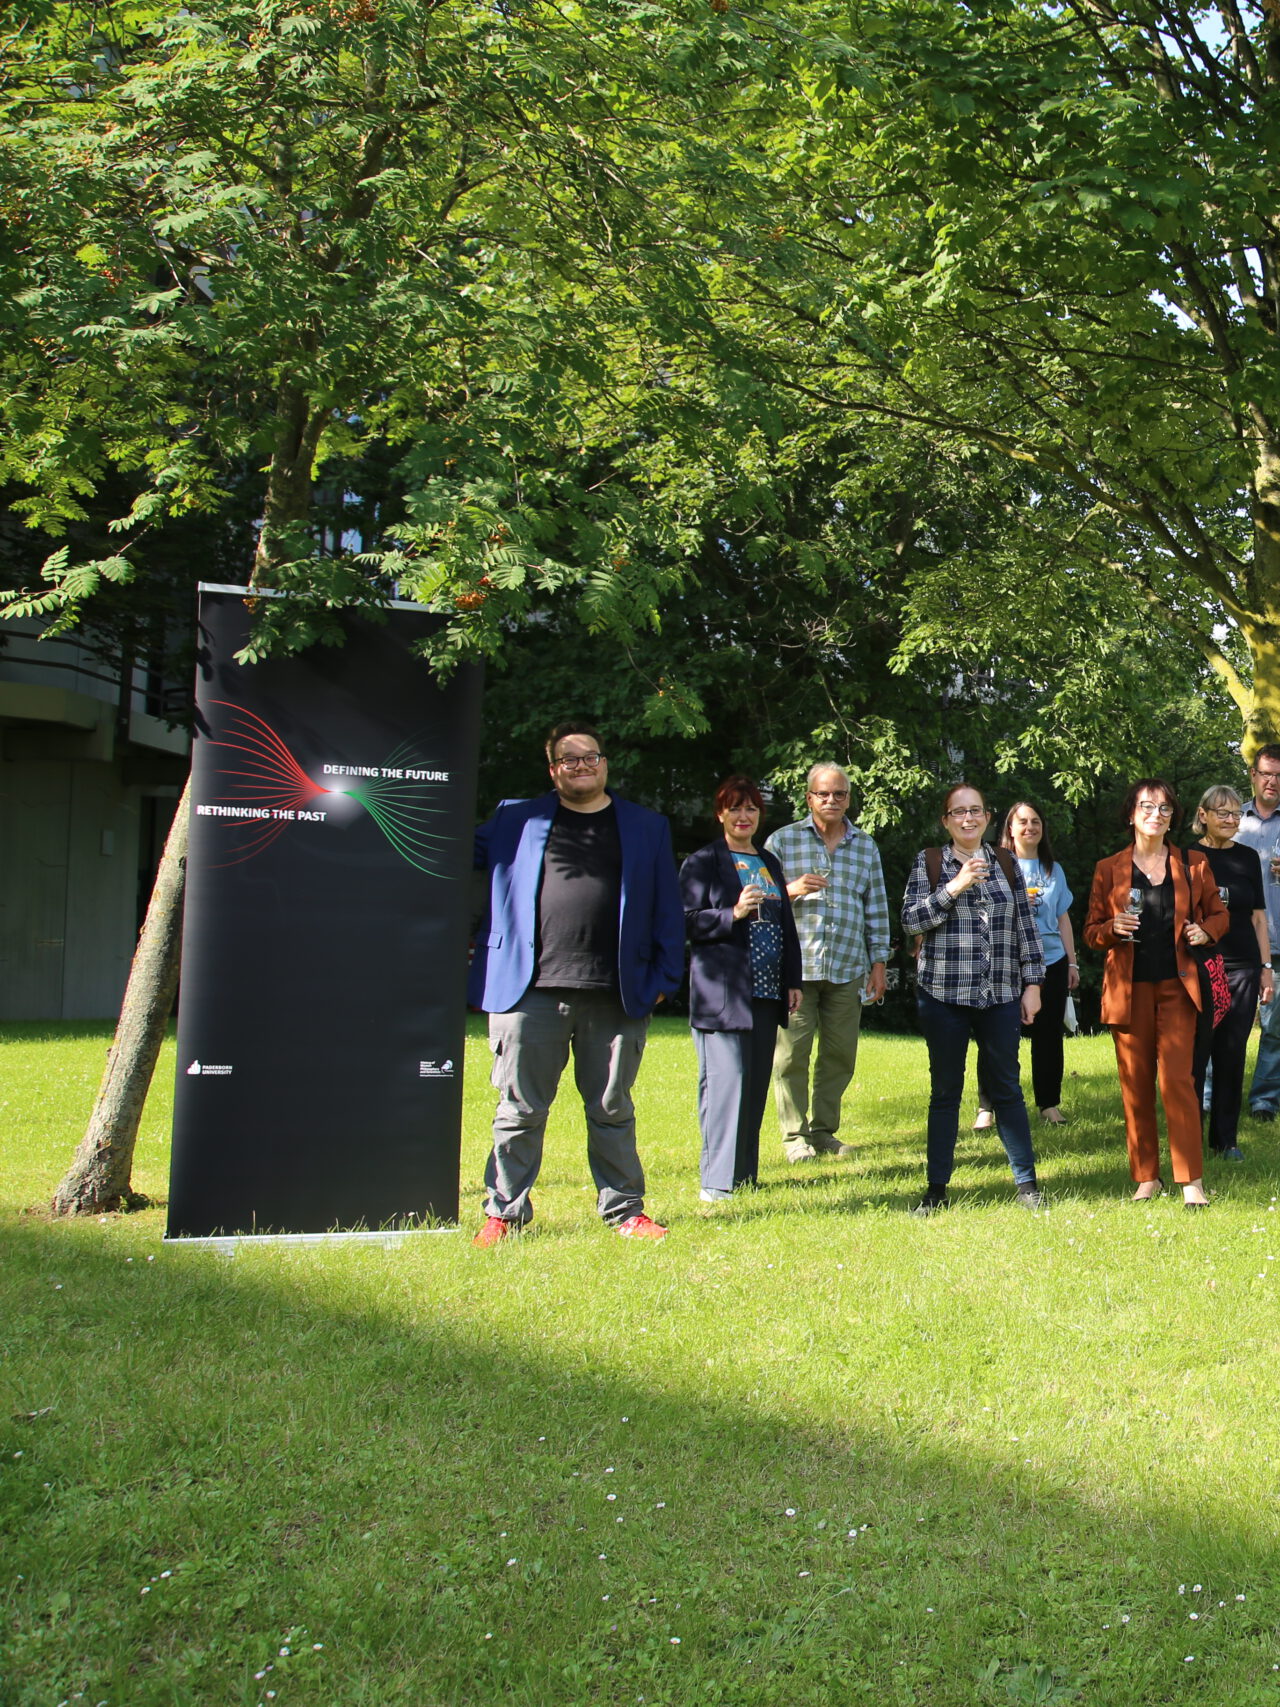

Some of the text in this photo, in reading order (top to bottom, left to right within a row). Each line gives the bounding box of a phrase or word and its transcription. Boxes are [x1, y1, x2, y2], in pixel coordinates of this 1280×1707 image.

[323, 764, 449, 782] DEFINING THE FUTURE
[196, 805, 327, 822] RETHINKING THE PAST
